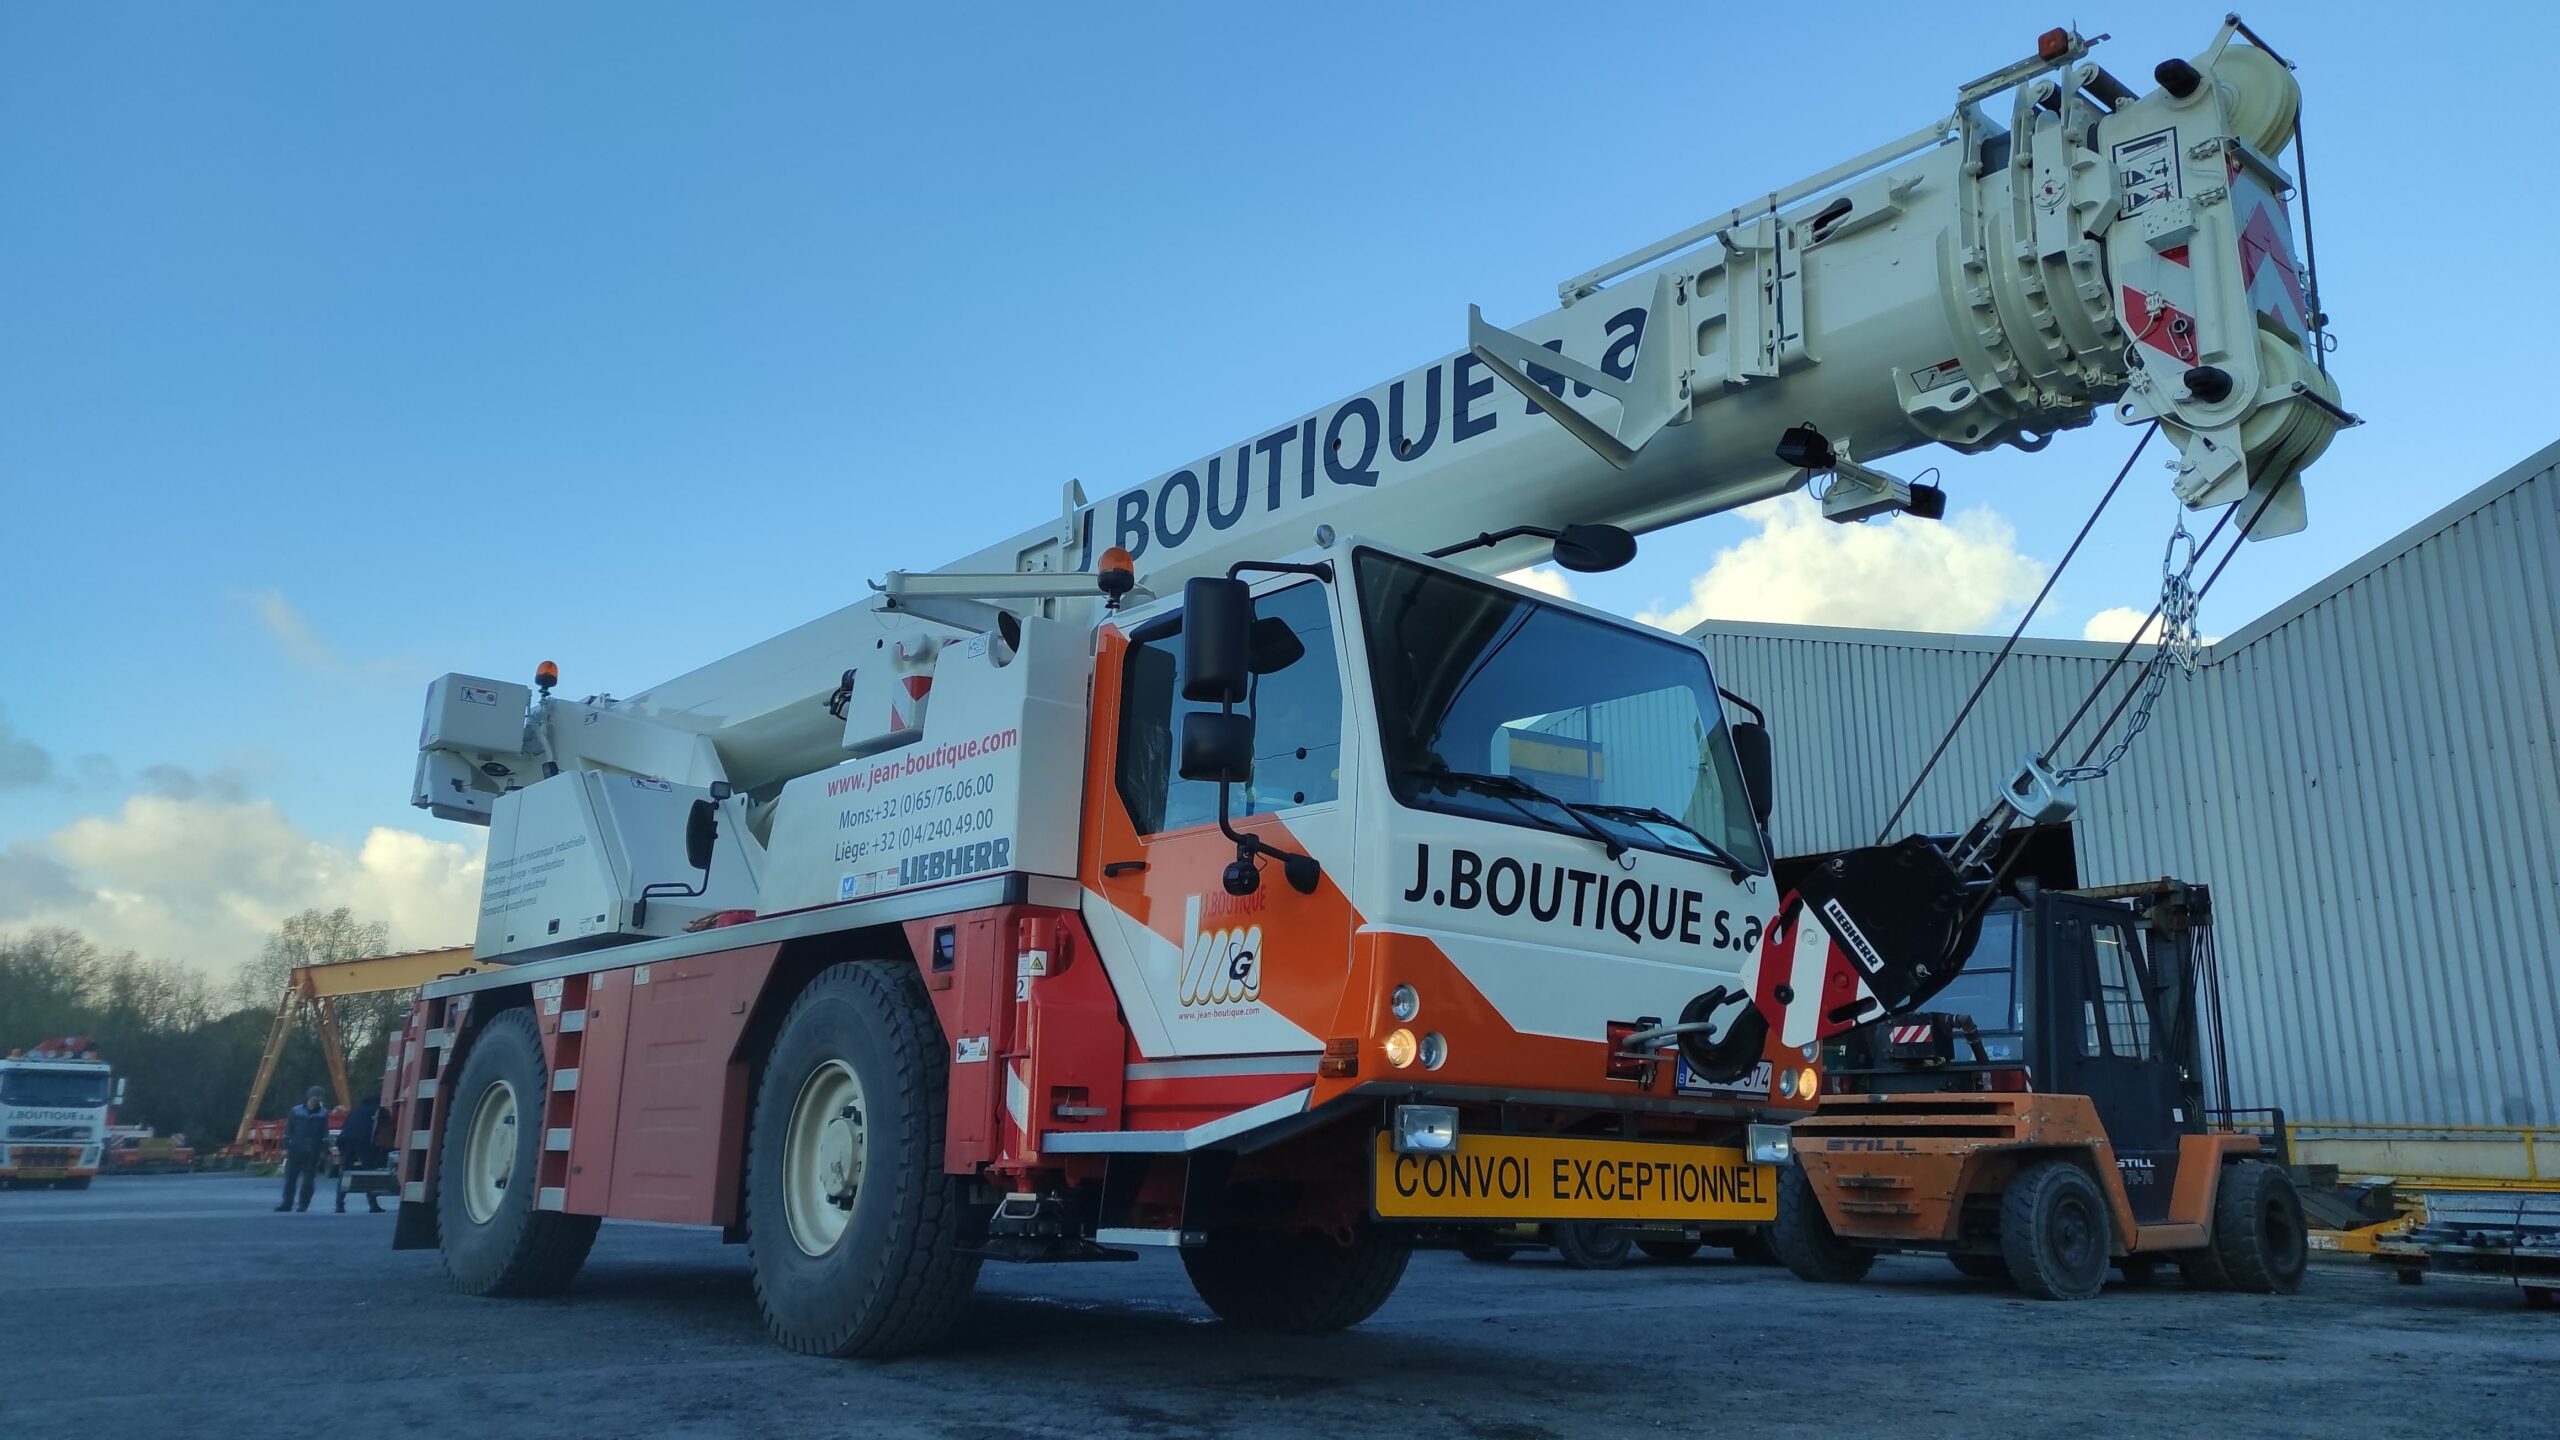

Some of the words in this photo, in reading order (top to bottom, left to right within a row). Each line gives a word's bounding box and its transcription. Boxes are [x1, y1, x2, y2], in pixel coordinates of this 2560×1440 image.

[900, 773, 994, 818] (0)65/76.06.00
[835, 840, 869, 863] Liège:
[872, 831, 896, 853] +32
[898, 808, 993, 850] (0)4/240.49.00
[900, 837, 1010, 886] LIEBHERR
[1404, 843, 1703, 944] J.BOUTIQUE
[1828, 904, 1879, 968] LIEBHERR
[8, 1110, 78, 1120] J.BOUTIQUE
[1826, 1138, 1917, 1151] STILL
[2116, 1158, 2156, 1168] STILL
[1395, 1153, 1530, 1199] CONVOI
[1553, 1158, 1767, 1204] EXCEPTIONNEL
